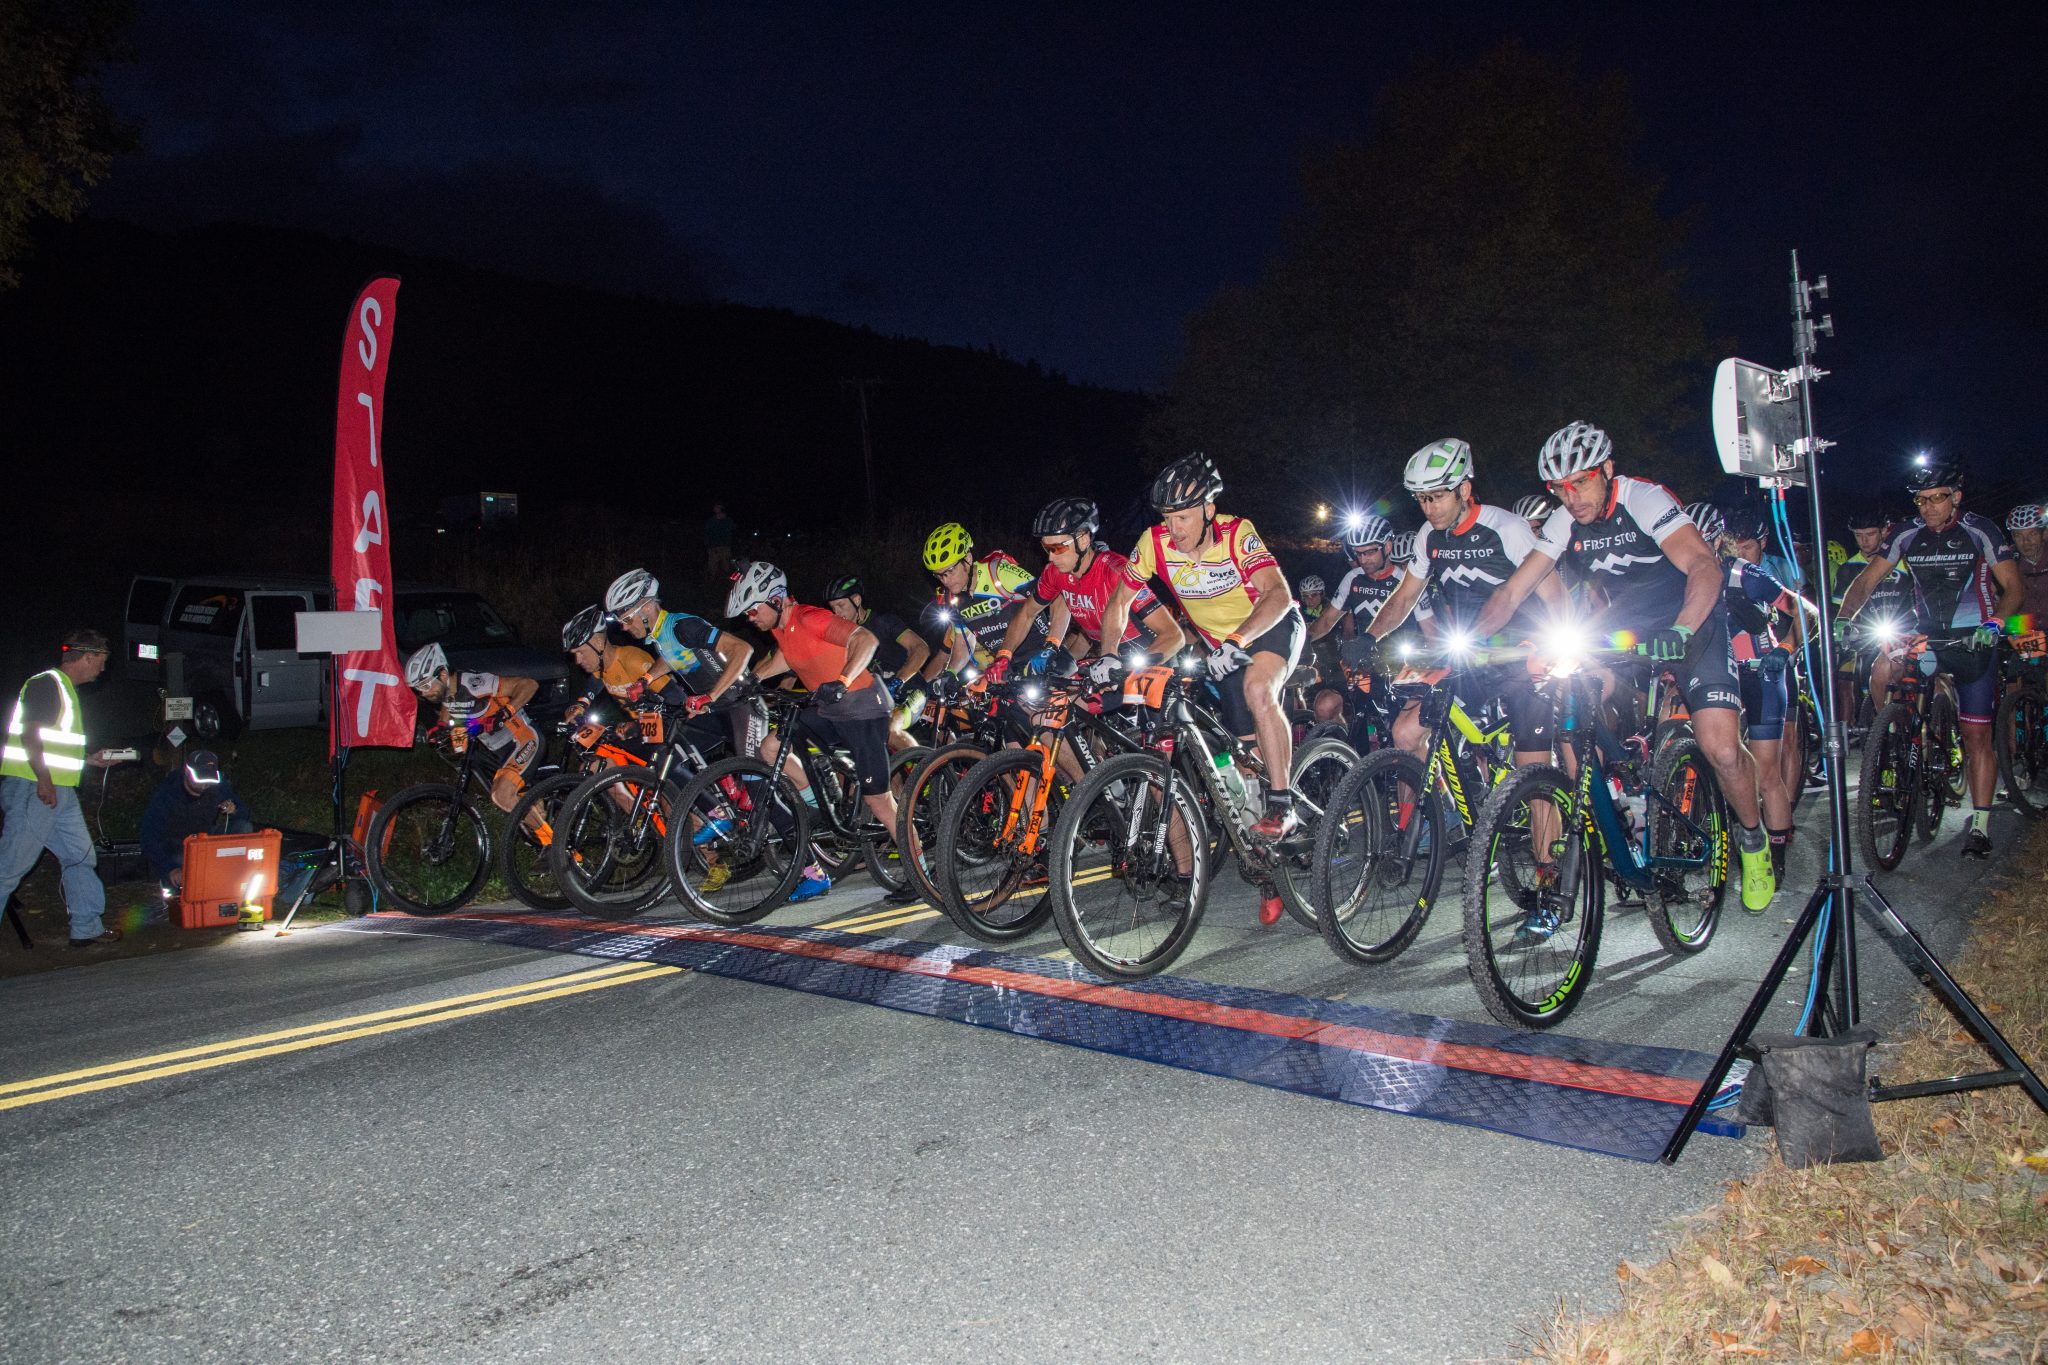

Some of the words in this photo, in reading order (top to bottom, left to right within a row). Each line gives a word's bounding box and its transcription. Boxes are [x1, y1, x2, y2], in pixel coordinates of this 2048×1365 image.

[1583, 537, 1613, 550] FIRST
[1614, 531, 1637, 545] STOP
[1438, 550, 1462, 559] FIRST
[1464, 549, 1494, 559] STOP
[1062, 589, 1095, 610] PEAK
[1358, 586, 1379, 595] FIRST
[1871, 590, 1900, 600] vittoria
[978, 622, 1008, 636] vittoria
[1136, 676, 1155, 697] 17
[516, 740, 535, 763] MASON
[1721, 831, 1729, 882] MAXXIS
